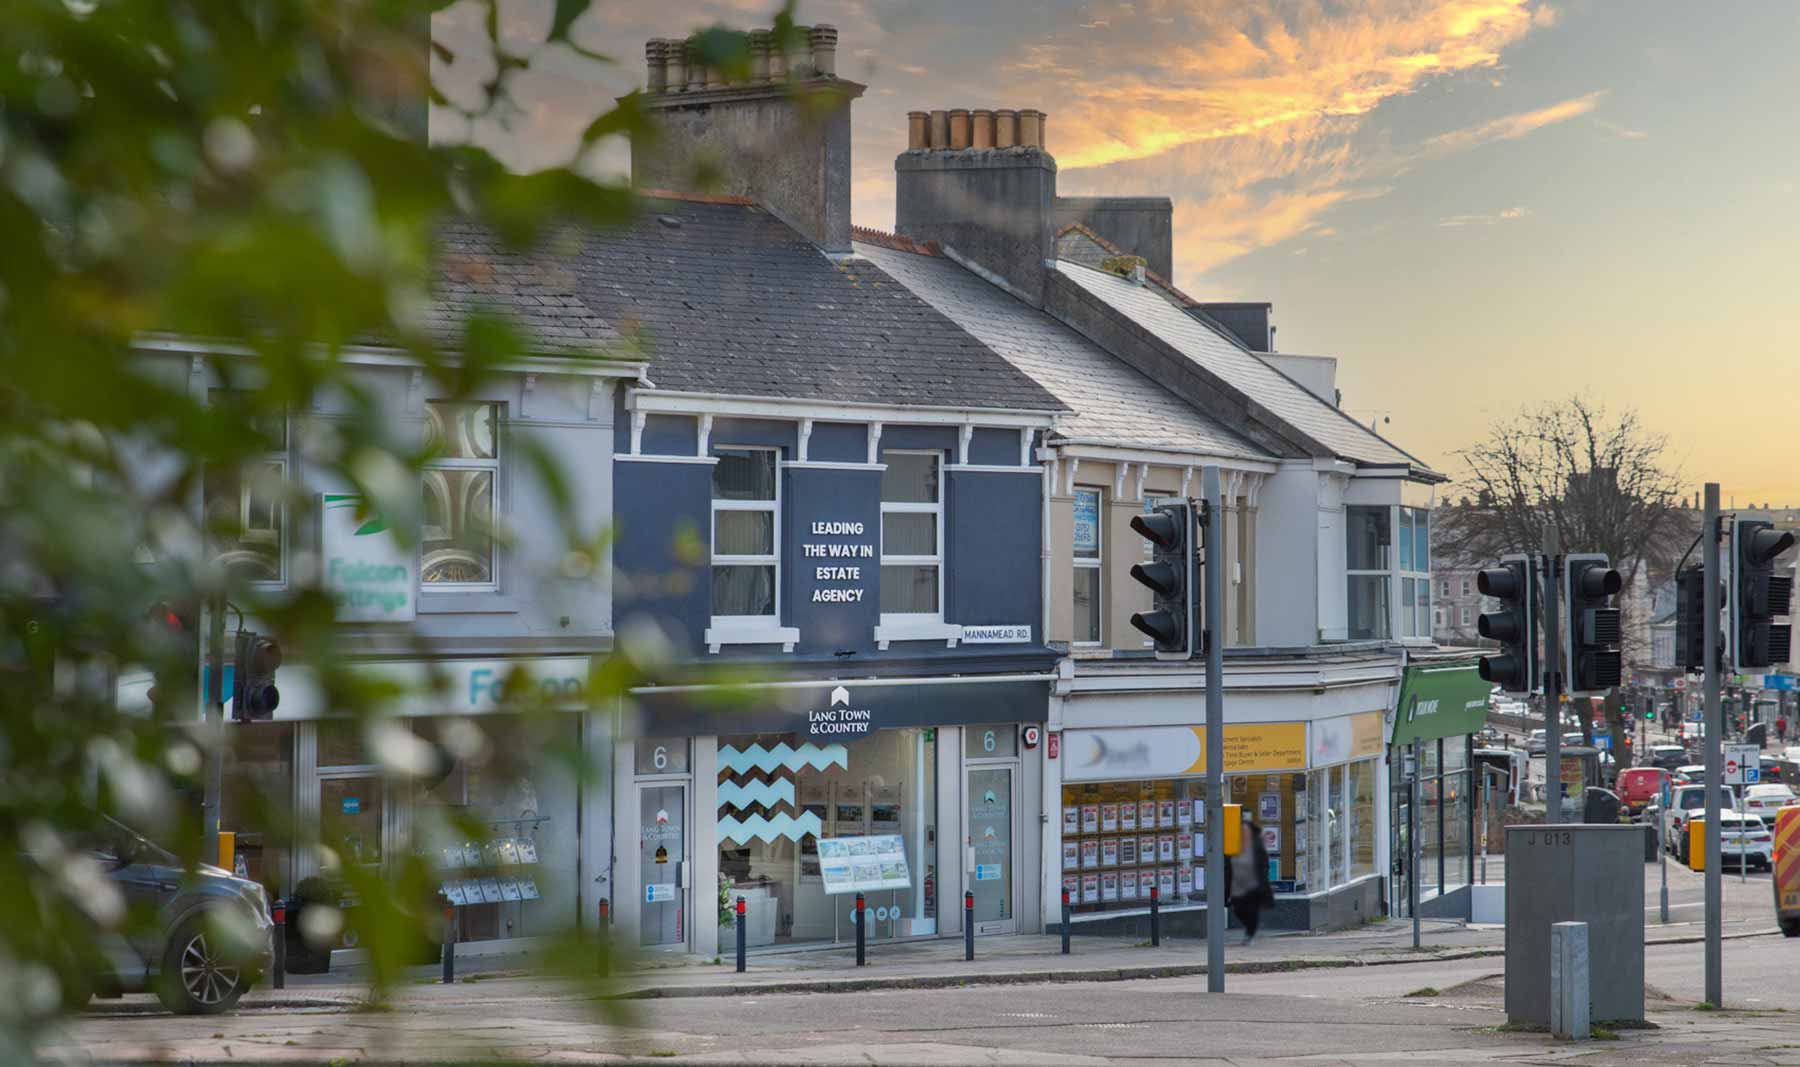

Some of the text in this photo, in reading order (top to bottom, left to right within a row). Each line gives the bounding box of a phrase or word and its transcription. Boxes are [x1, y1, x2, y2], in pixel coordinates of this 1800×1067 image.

[812, 522, 864, 535] LEADING
[803, 544, 873, 557] THE WAY IN
[816, 567, 860, 580] ESTATE
[812, 589, 864, 602] AGENCY
[964, 629, 1014, 639] MANNAMEAD
[809, 709, 870, 722] LANG TOWN
[983, 730, 997, 753] 6
[653, 746, 668, 769] 6
